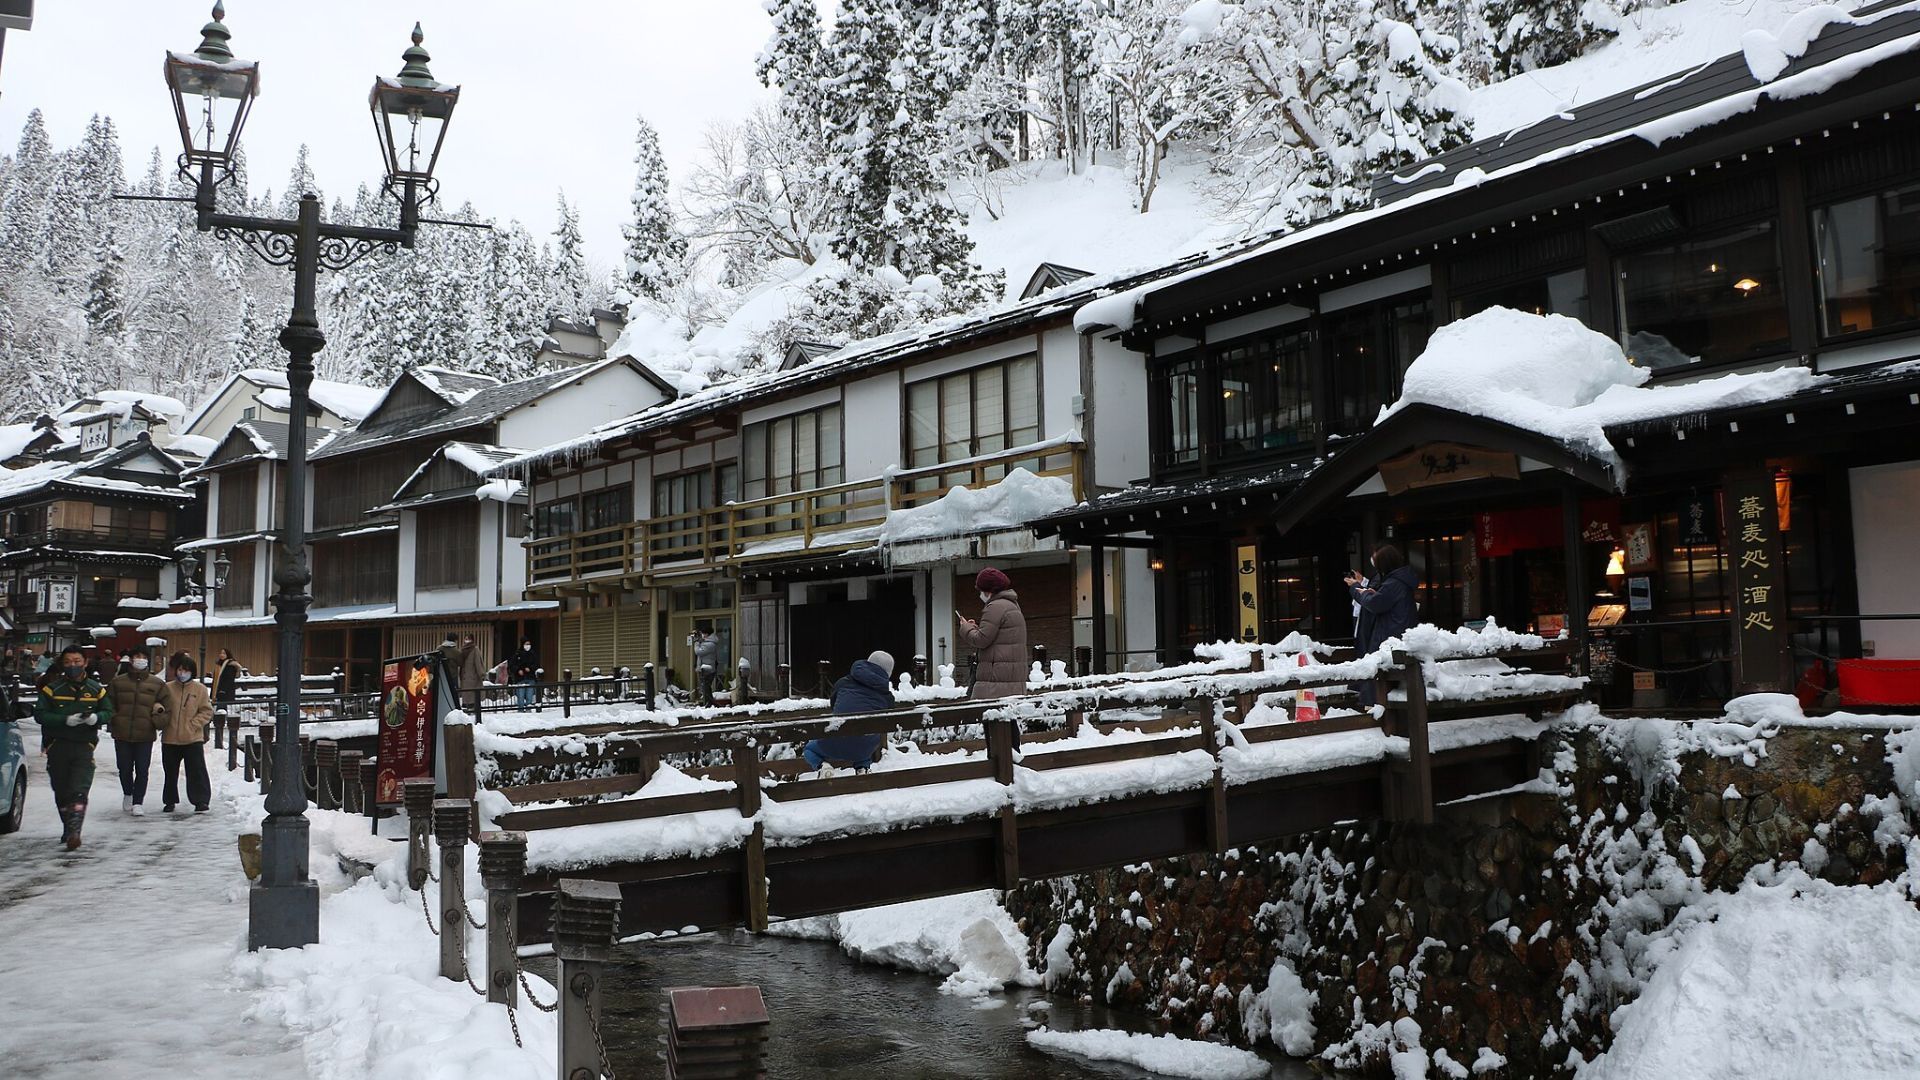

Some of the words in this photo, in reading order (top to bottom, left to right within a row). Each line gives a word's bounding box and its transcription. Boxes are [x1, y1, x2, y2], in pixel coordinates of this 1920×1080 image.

[1738, 495, 1775, 631] 蕎麦処・酒処
